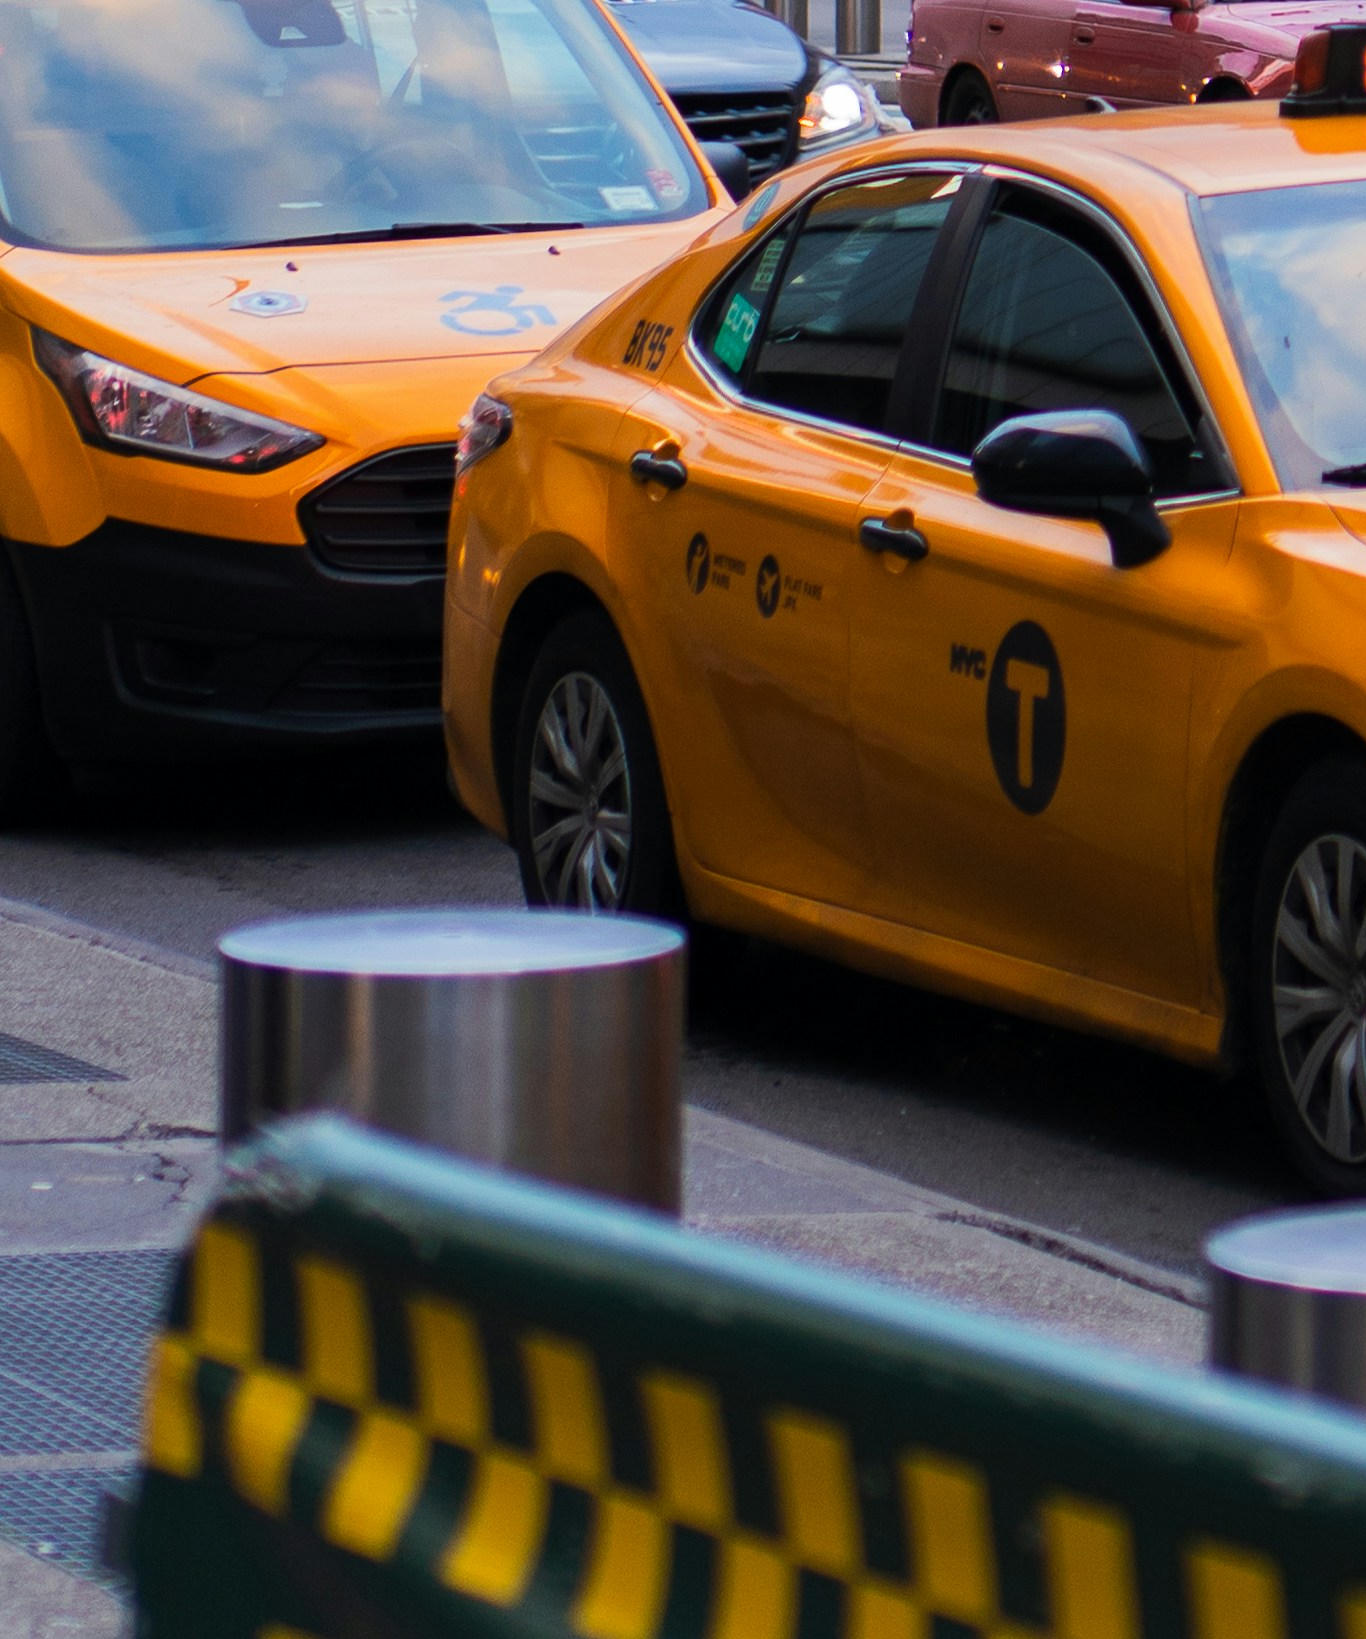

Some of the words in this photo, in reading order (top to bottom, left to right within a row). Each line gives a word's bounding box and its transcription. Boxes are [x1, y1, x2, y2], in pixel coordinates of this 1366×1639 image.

[622, 319, 674, 372] 8K95
[724, 303, 759, 343] curb
[950, 642, 987, 681] NYC
[1006, 657, 1049, 789] T
